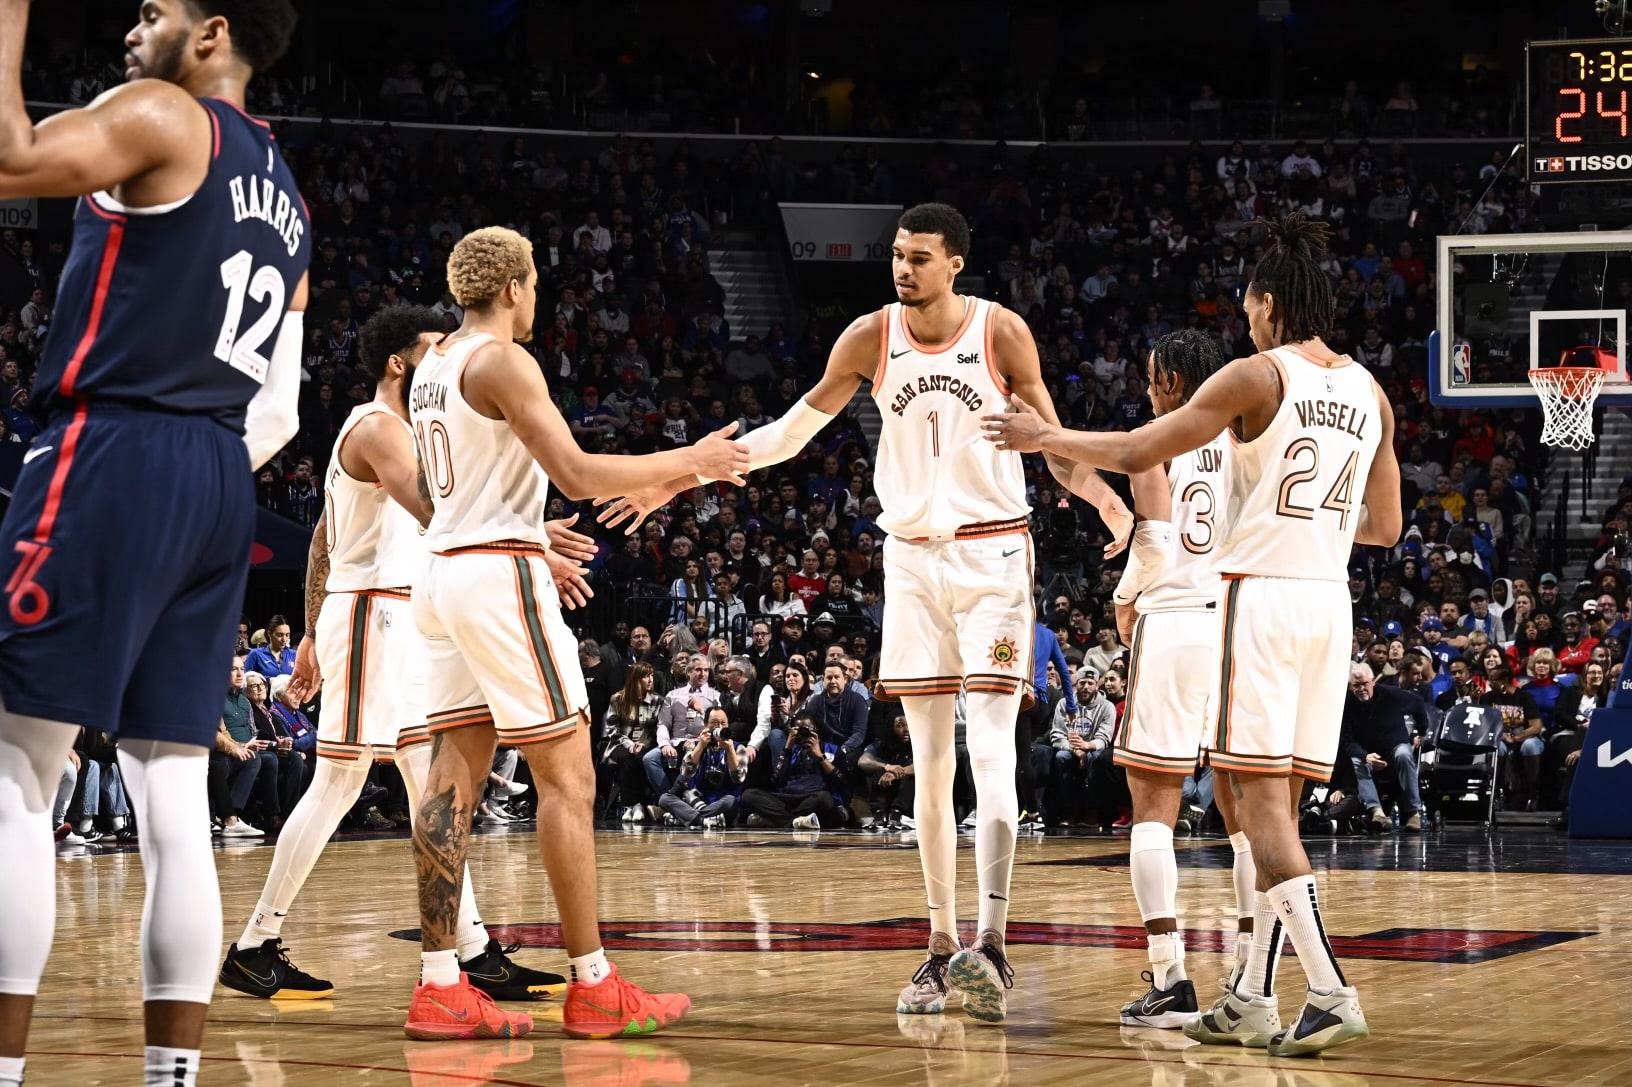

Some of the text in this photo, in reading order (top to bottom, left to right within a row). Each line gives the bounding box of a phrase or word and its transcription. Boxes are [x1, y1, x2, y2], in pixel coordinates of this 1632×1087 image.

[1569, 50, 1632, 82] 7:32
[1555, 88, 1627, 143] 24
[1565, 154, 1632, 172] TISSO
[229, 174, 303, 257] HARRIS
[831, 243, 850, 256] EXIT
[213, 250, 285, 385] 12
[956, 353, 980, 364] Self.
[412, 381, 448, 413] SOCHAN
[890, 374, 983, 417] SAN ANTONIO
[1126, 409, 1137, 418] 21
[674, 431, 685, 439] 21
[927, 410, 940, 457] 1
[1294, 399, 1367, 441] VASSELL
[417, 419, 455, 499] 10
[1275, 436, 1360, 531] 24
[1180, 480, 1216, 555] 3
[4, 540, 53, 625] 76
